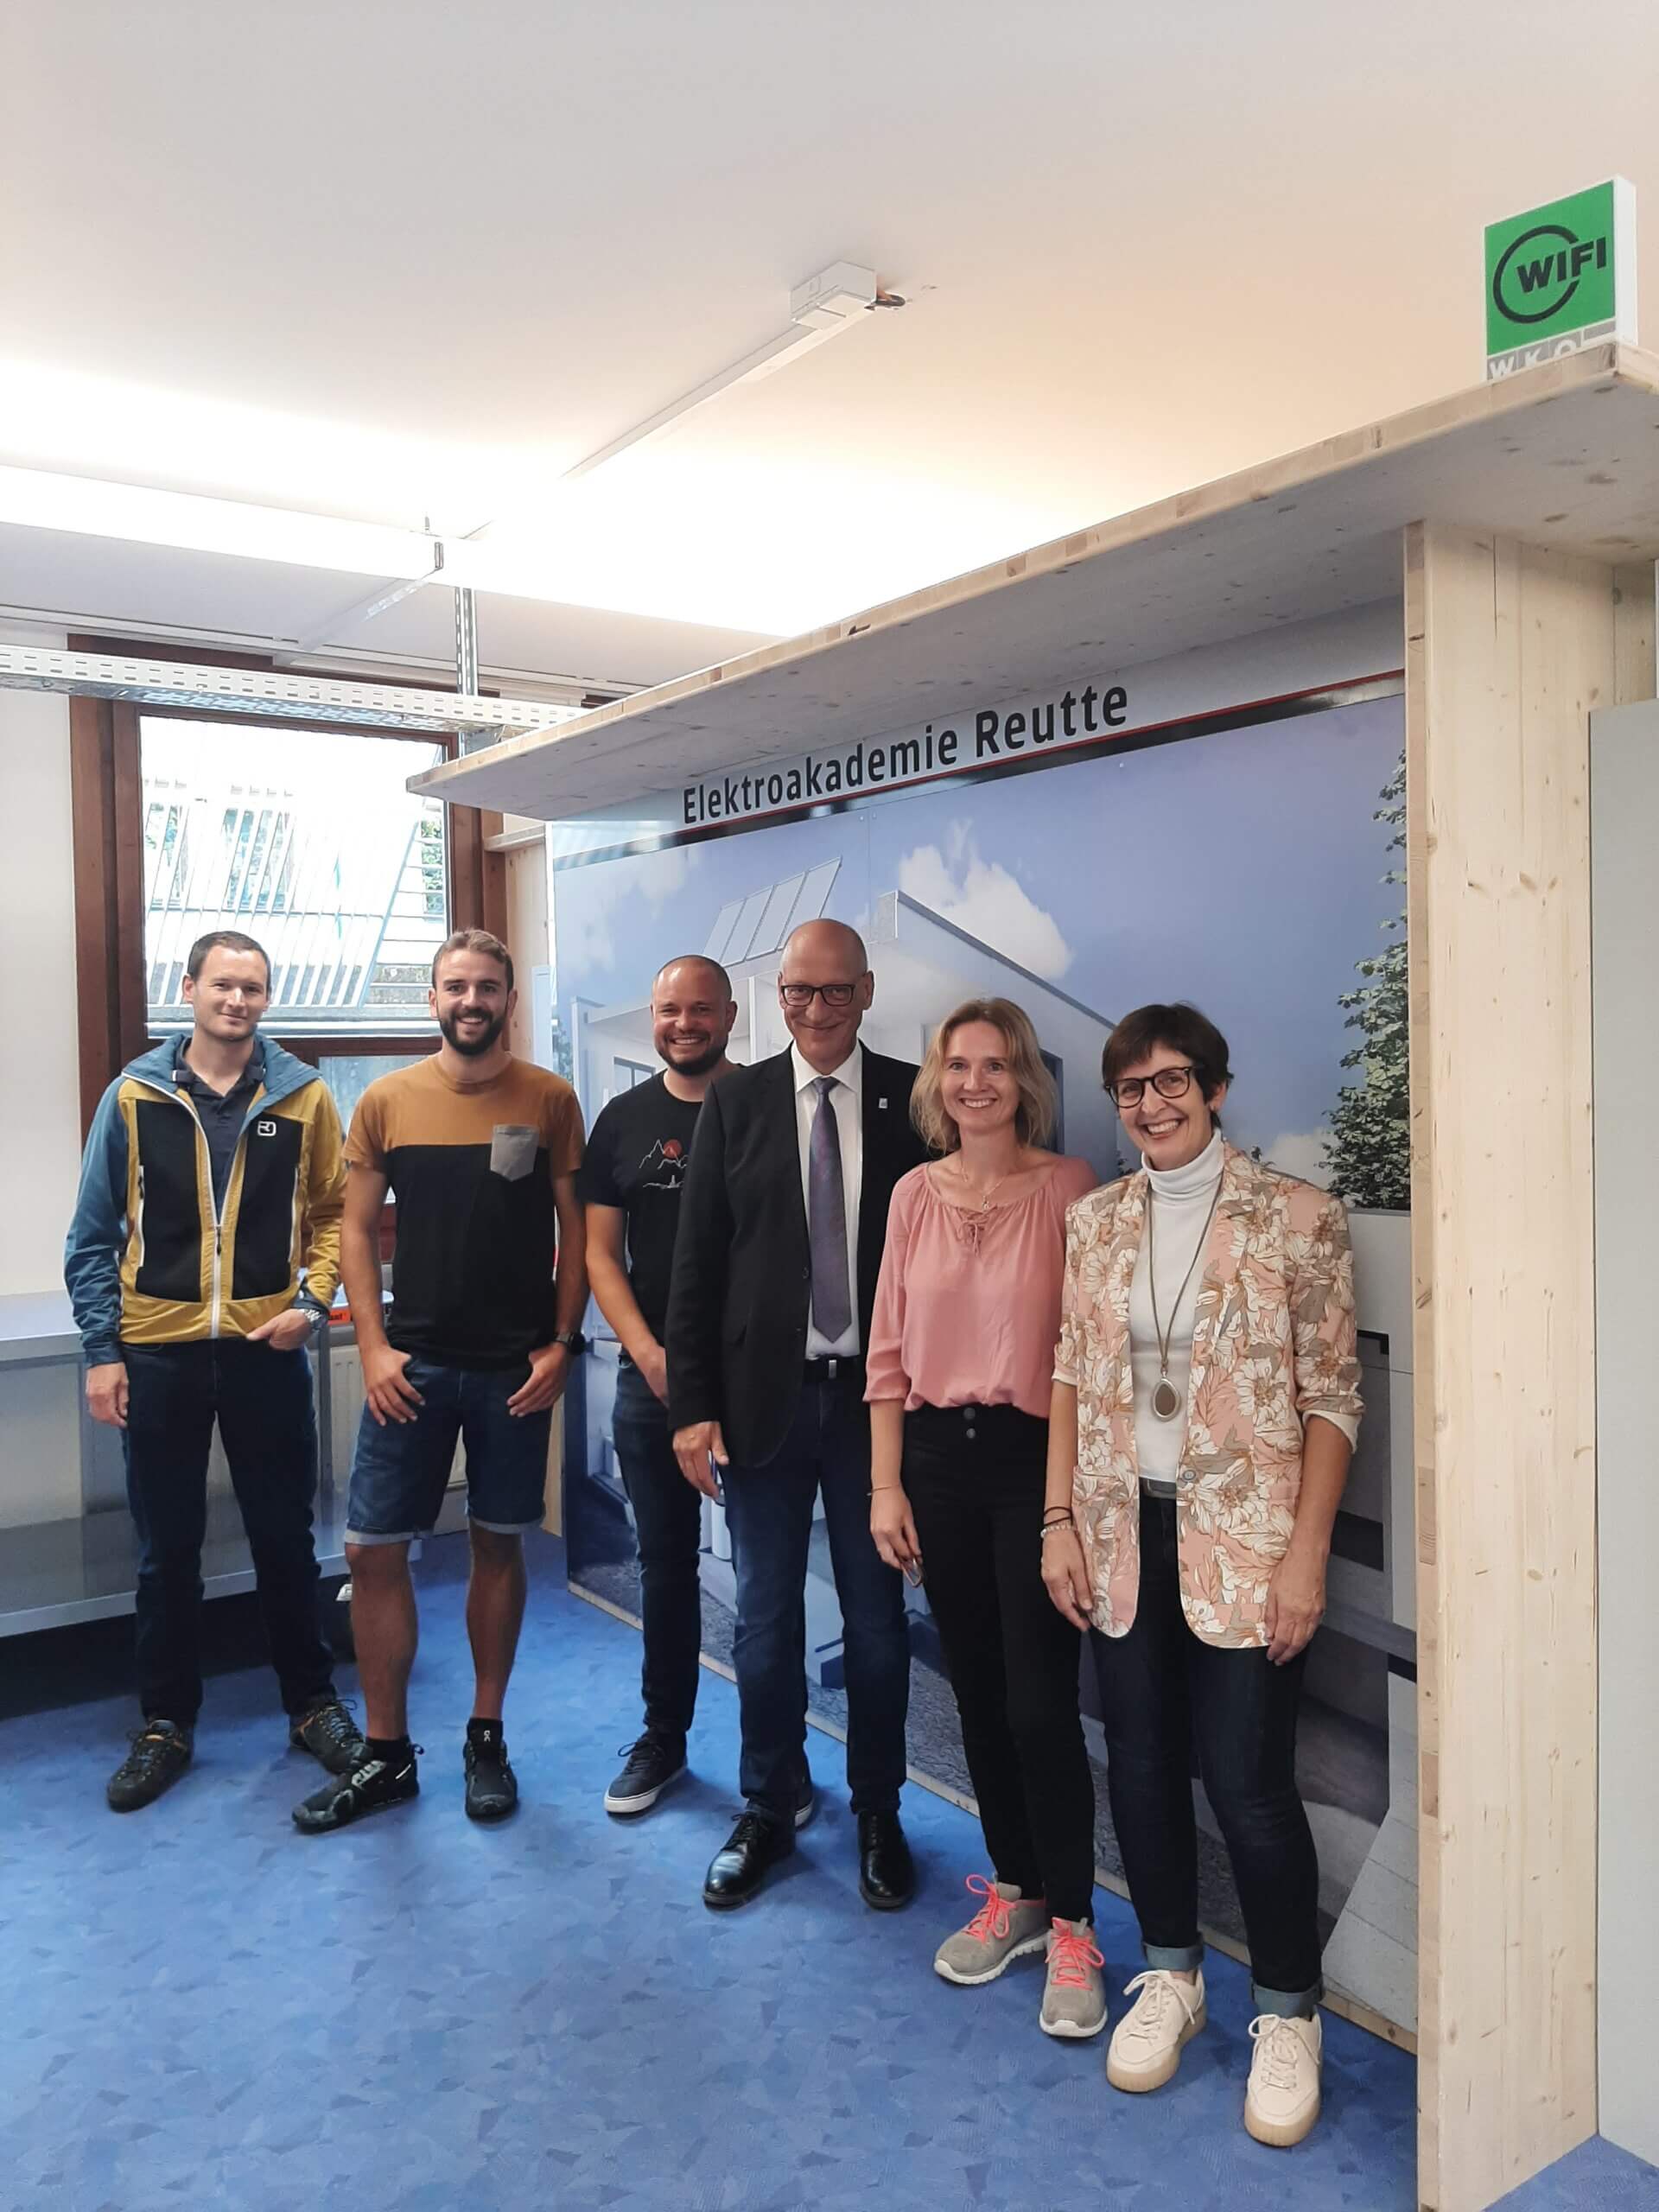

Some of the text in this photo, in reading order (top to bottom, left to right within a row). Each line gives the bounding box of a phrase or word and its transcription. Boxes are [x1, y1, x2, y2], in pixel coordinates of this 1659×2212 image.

[1516, 236, 1607, 294] WIFI
[683, 684, 1128, 824] Elektroakademie Reutte
